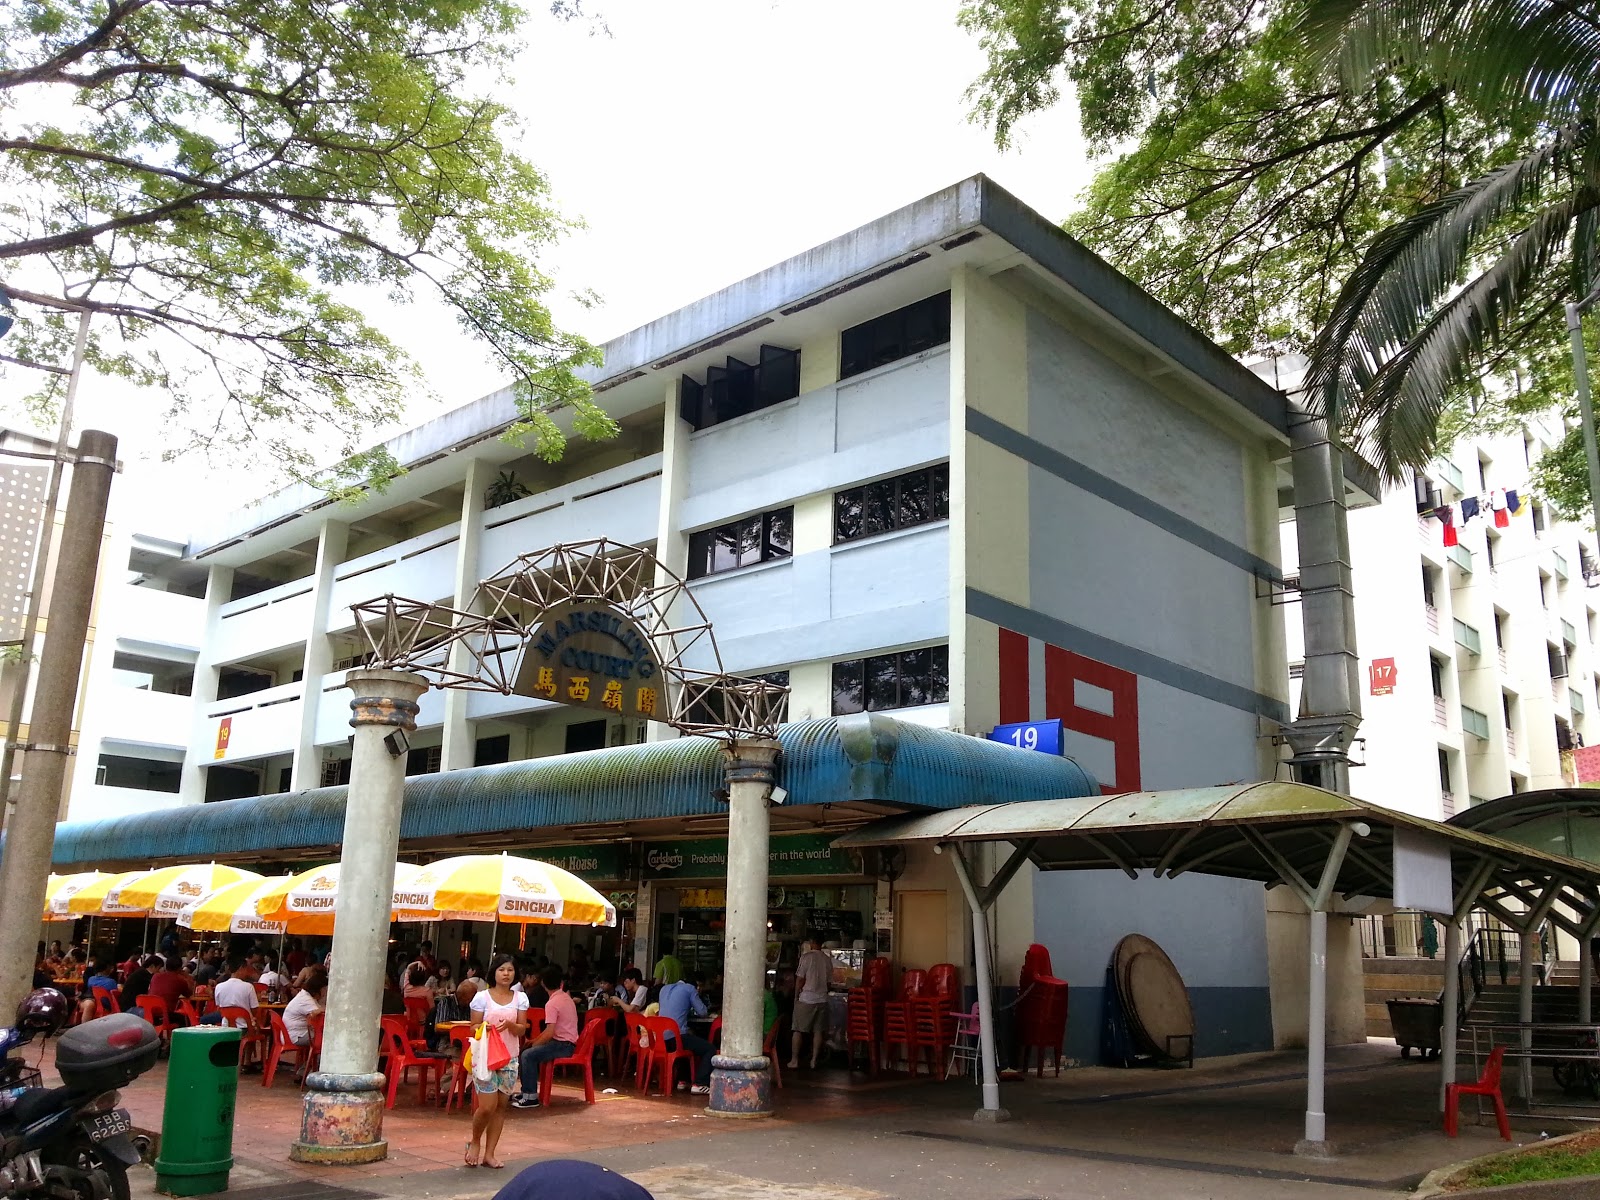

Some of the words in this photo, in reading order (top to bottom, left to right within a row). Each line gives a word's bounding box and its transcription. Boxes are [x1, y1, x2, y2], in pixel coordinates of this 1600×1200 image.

[535, 612, 655, 678] MARSILING
[561, 647, 634, 680] COURT
[1376, 666, 1391, 678] 17
[221, 727, 229, 740] 19
[1011, 727, 1038, 750] 19
[568, 856, 598, 870] House
[647, 848, 683, 871] Carlsberg
[779, 851, 788, 860] in
[789, 849, 804, 860] the
[805, 848, 831, 859] world
[292, 897, 335, 908] SINGHA
[392, 893, 429, 905] SINGHA
[504, 900, 556, 914] SINGHA
[237, 919, 283, 931] SINGHA
[94, 1111, 121, 1128] FBB
